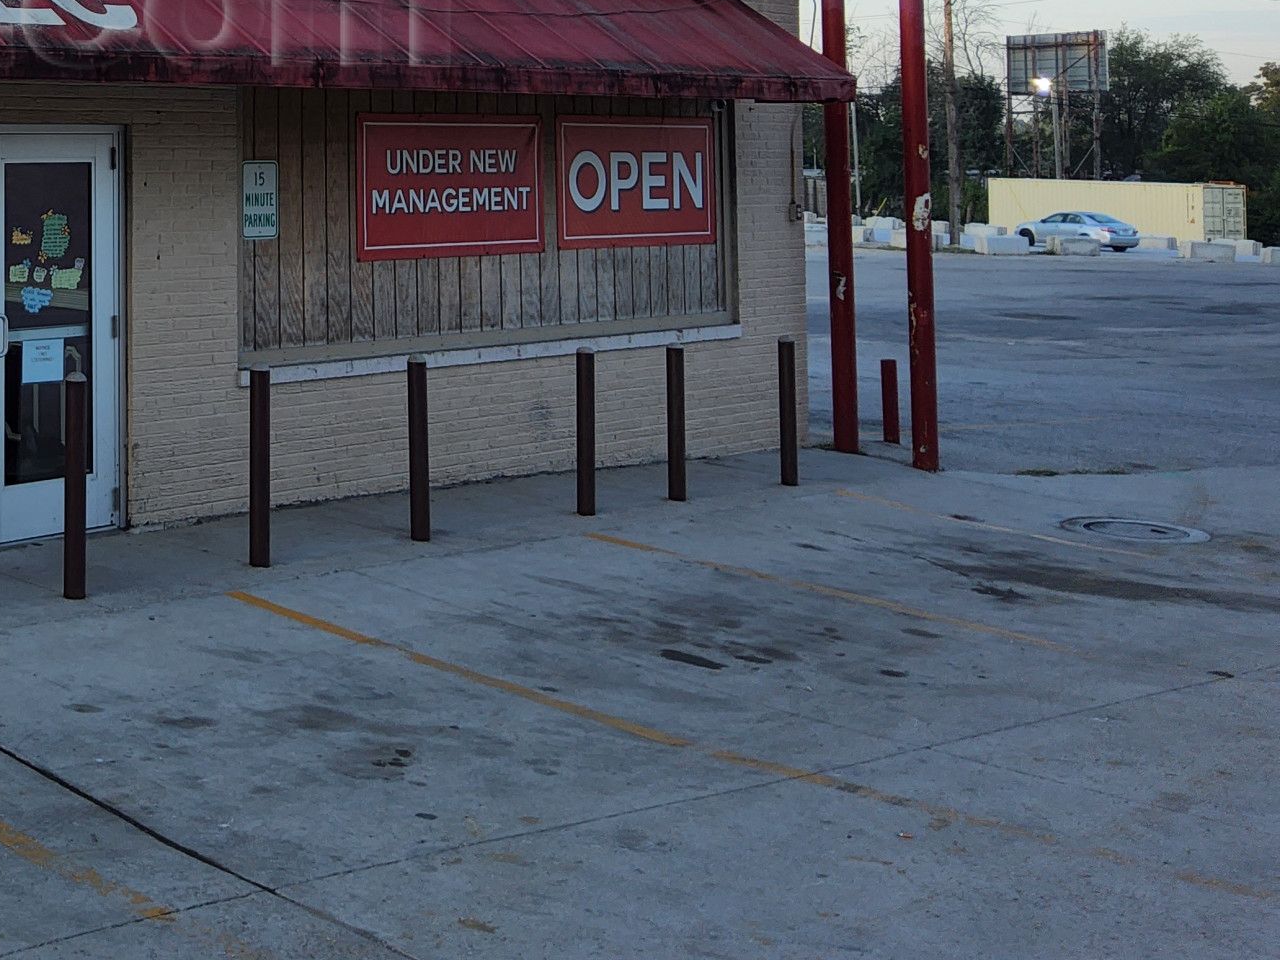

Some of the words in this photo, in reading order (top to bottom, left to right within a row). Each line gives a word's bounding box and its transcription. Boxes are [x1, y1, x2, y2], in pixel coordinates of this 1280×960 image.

[386, 148, 462, 176] UNDER
[469, 148, 518, 174] NEW
[254, 171, 265, 187] 15
[568, 150, 704, 212] OPEN
[245, 192, 275, 208] MINUTE
[371, 185, 531, 215] MANAGEMENT
[244, 213, 276, 228] PARKING
